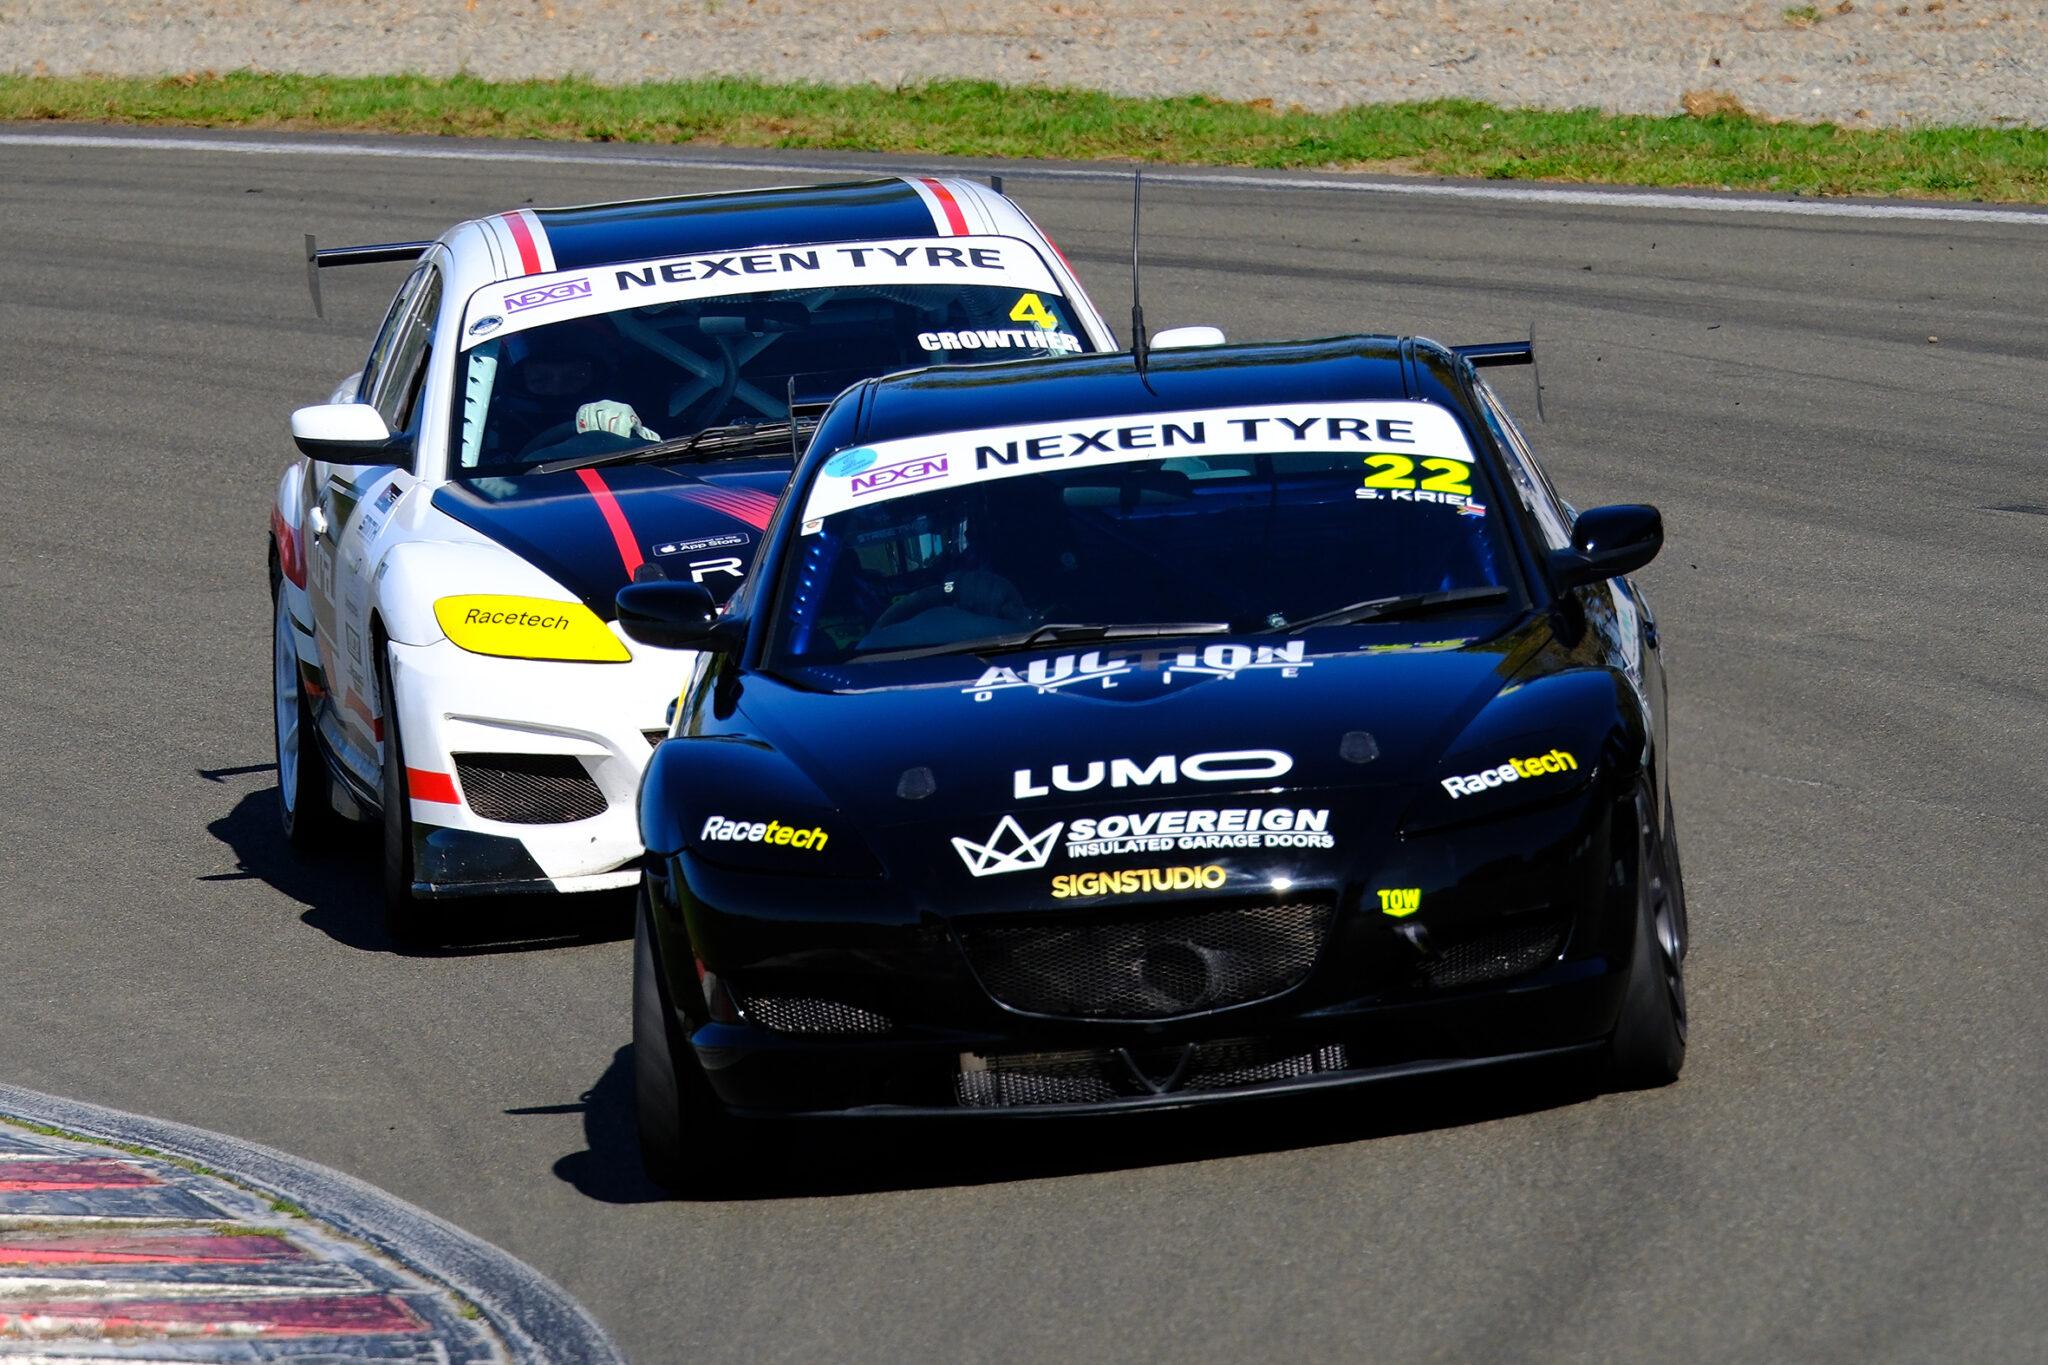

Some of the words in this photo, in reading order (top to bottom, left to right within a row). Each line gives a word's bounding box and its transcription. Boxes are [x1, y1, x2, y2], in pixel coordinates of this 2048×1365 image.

[616, 251, 820, 290] NEXEN
[837, 247, 1005, 270] TYRE
[504, 281, 592, 311] NEXEN
[1009, 293, 1057, 329] 4
[917, 330, 1083, 352] CROWTHER
[975, 421, 1205, 470] NEXEN
[1227, 417, 1415, 443] TYRE
[851, 458, 948, 492] NEXEN
[1363, 454, 1472, 495] 22
[1355, 488, 1385, 499] S.
[1391, 489, 1486, 510] KRIEL
[680, 541, 706, 551] App
[709, 538, 741, 547] Store
[464, 608, 569, 630] Racetech
[1014, 750, 1293, 799] LUMO
[1441, 749, 1577, 799] Racetech
[701, 816, 828, 851] Racetech
[1067, 808, 1329, 842] SOVEREIGN
[1068, 837, 1173, 858] INSULATED
[1178, 834, 1260, 849] GARAGE
[1264, 834, 1335, 849] DOORS
[1051, 865, 1226, 898] SIGNSTUDIO
[1377, 888, 1421, 910] TOW
